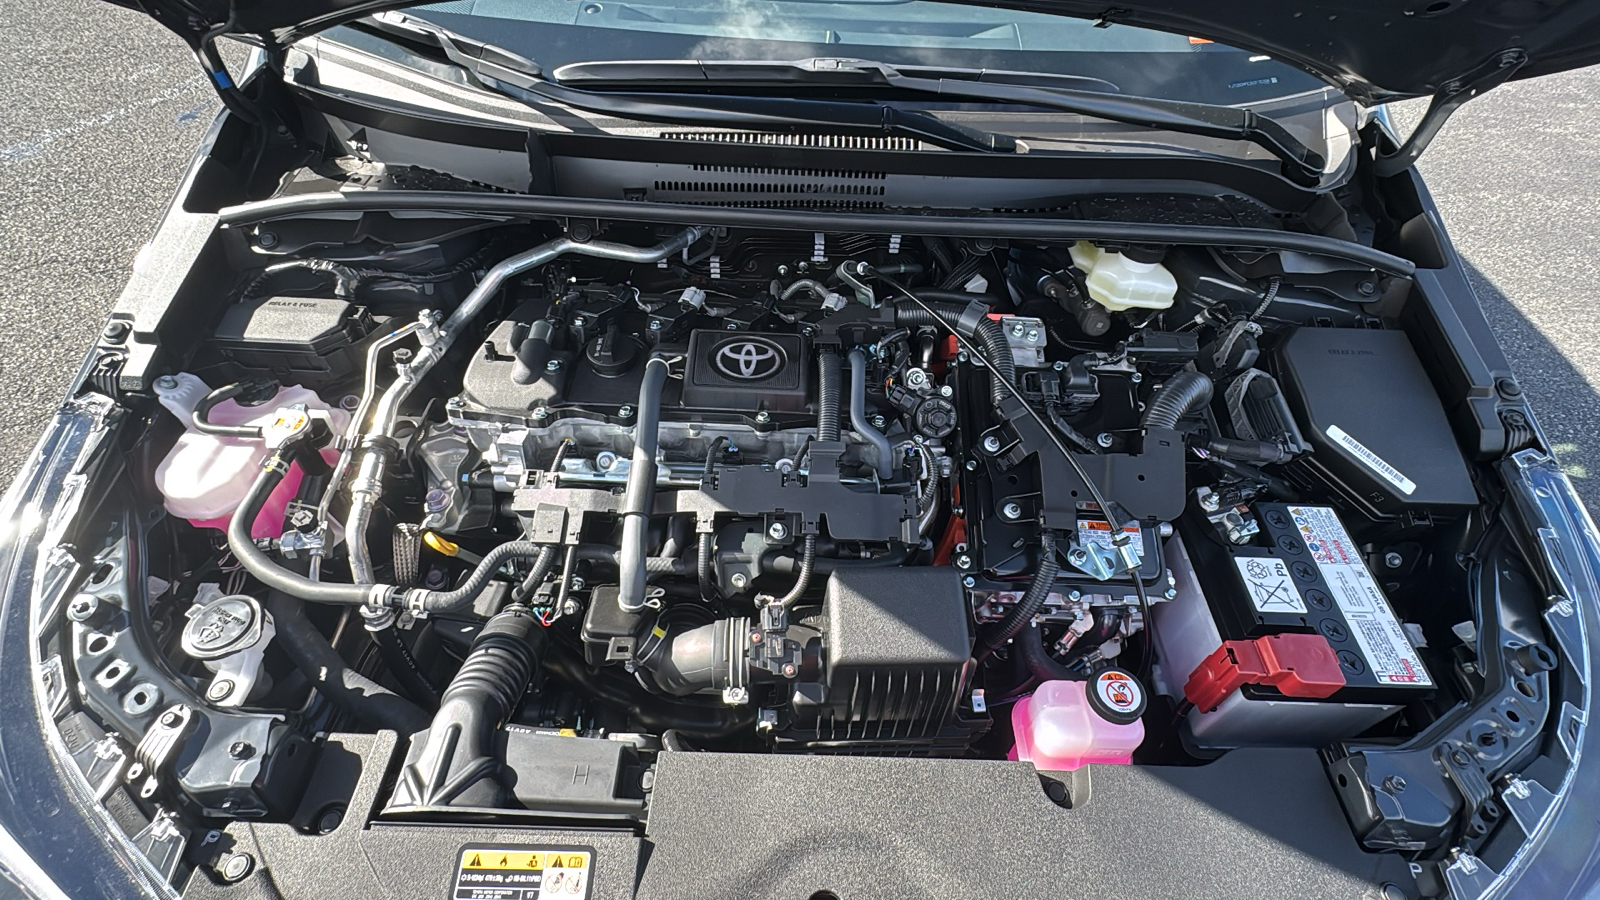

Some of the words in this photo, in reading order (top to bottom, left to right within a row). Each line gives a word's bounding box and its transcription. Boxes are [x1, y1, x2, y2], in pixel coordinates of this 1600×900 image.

[1274, 563, 1288, 576] Pb
[1367, 586, 1380, 606] YUASA
[1378, 606, 1386, 614] GS
